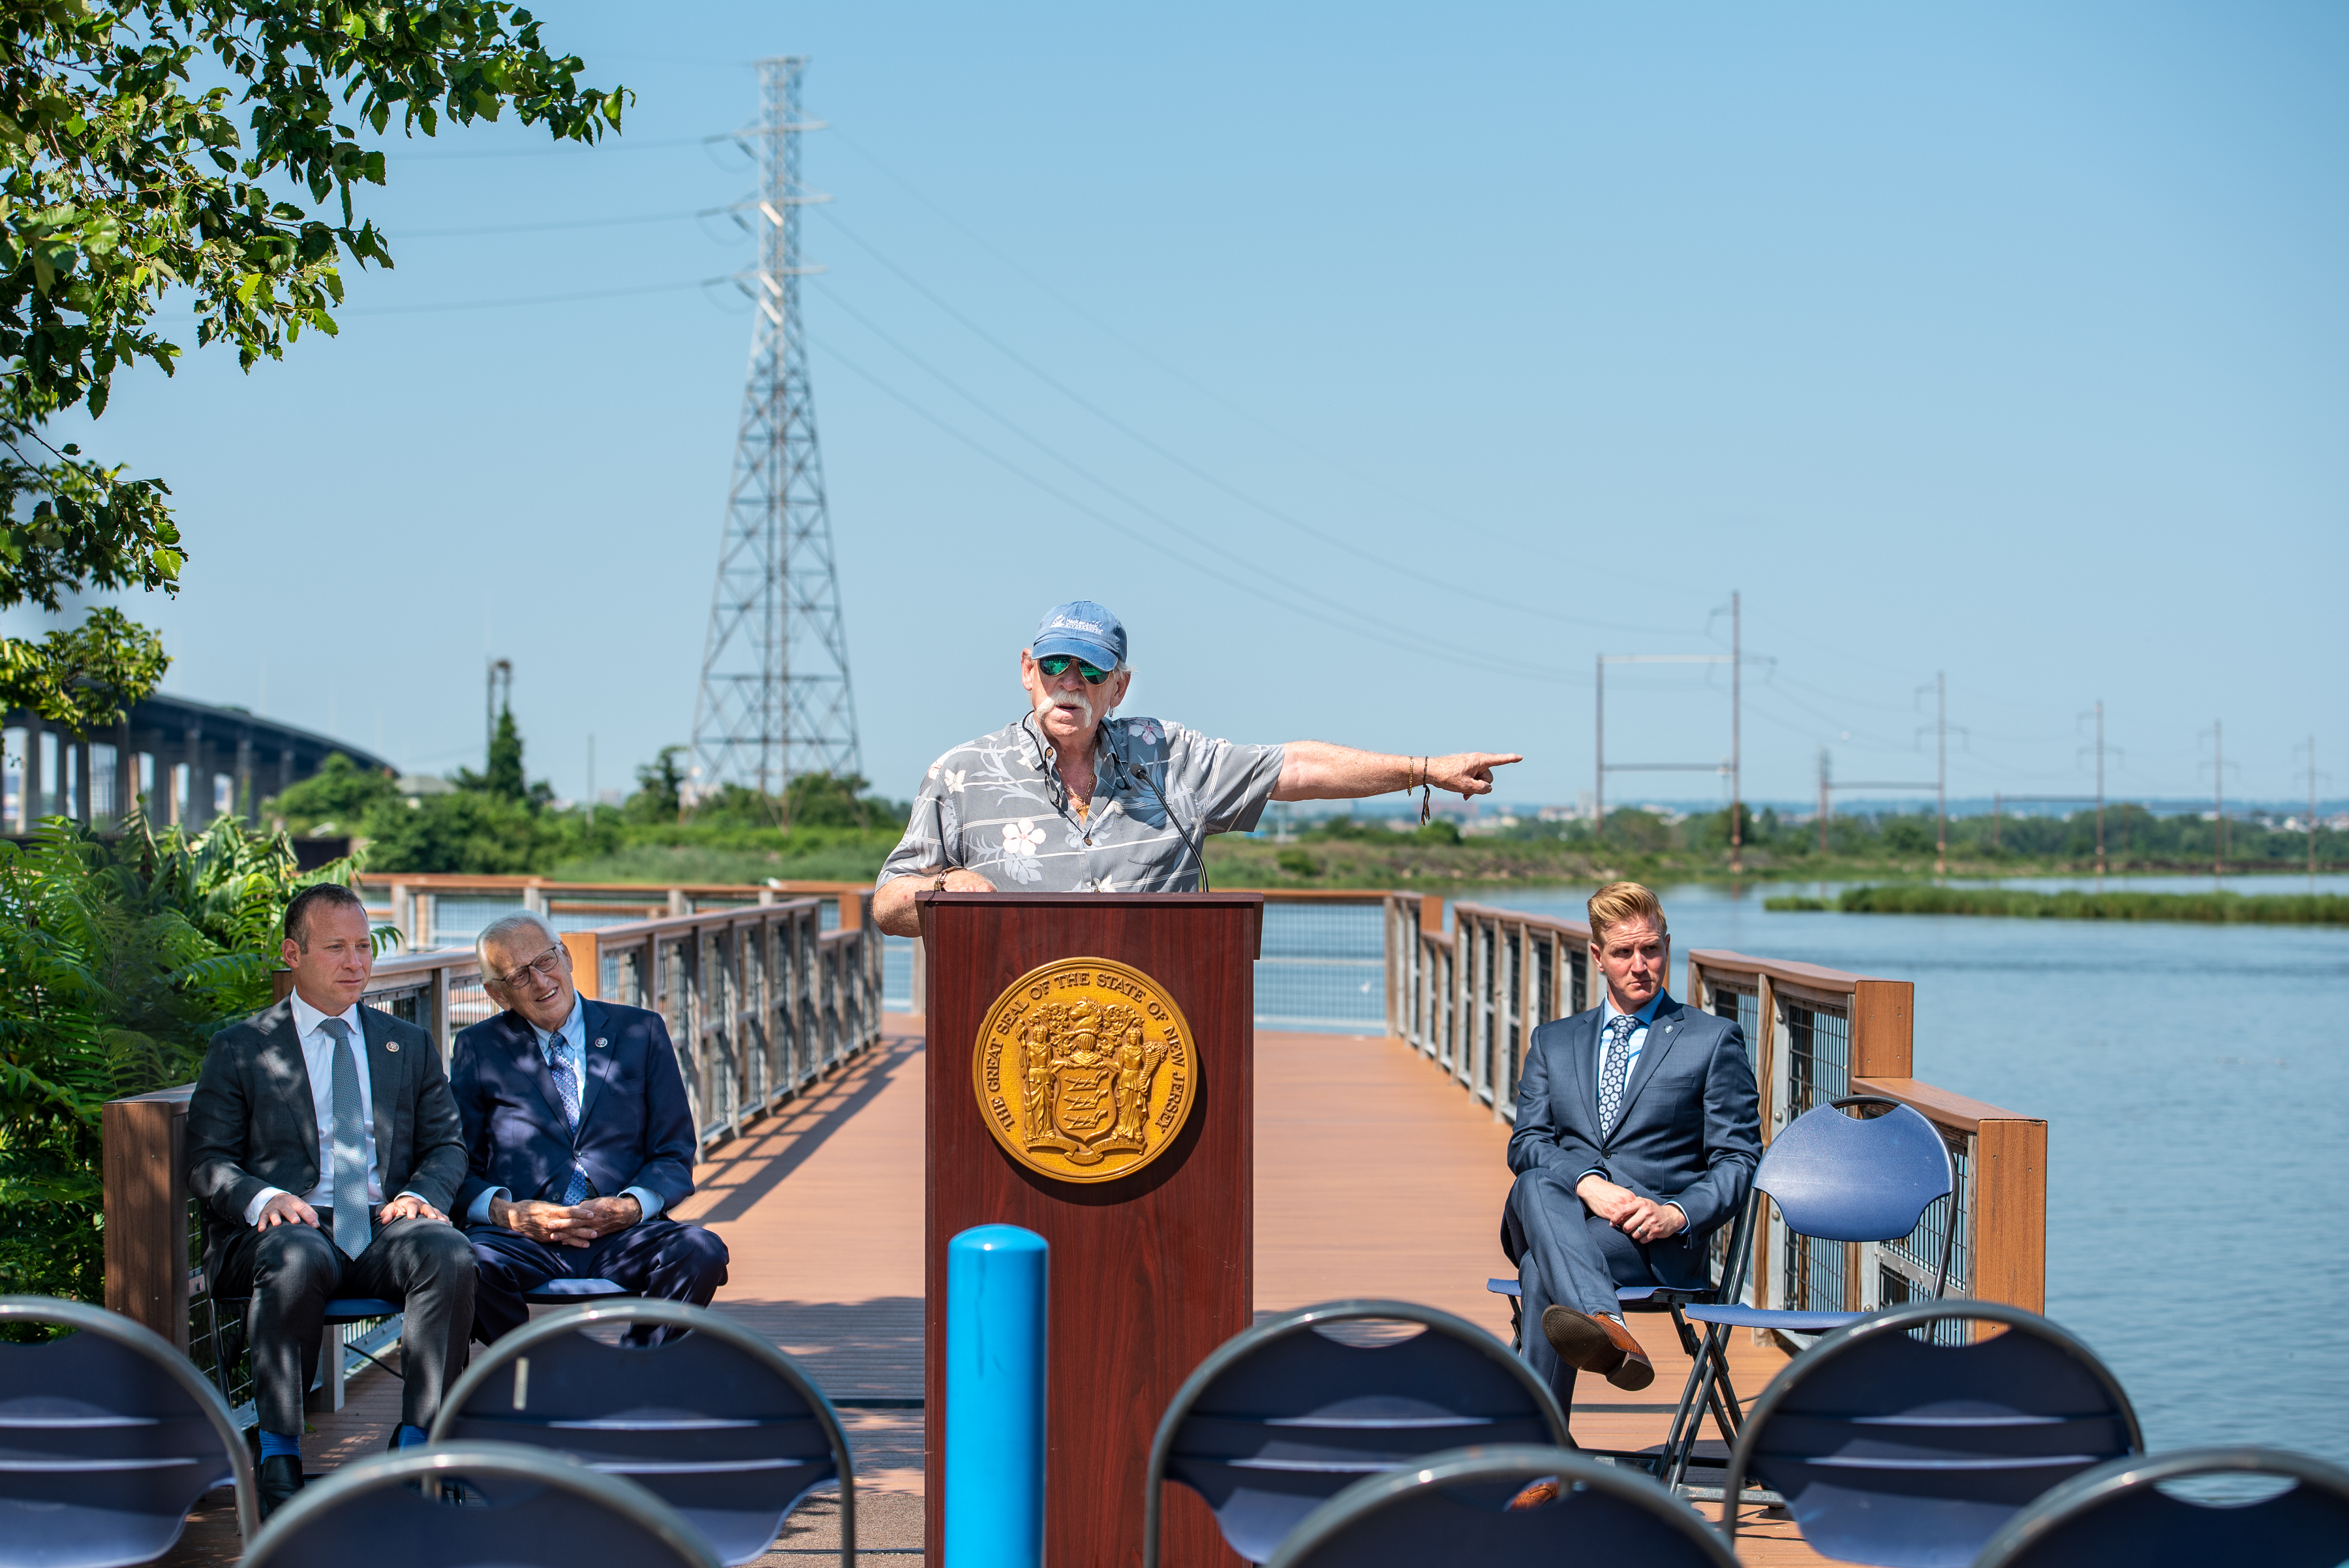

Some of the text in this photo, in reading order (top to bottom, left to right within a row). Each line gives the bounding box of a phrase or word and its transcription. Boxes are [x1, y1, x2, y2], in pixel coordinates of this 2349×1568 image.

[987, 972, 1185, 1133] THE GREAT SEAL OF THE STATE OF NEW JERSEY
